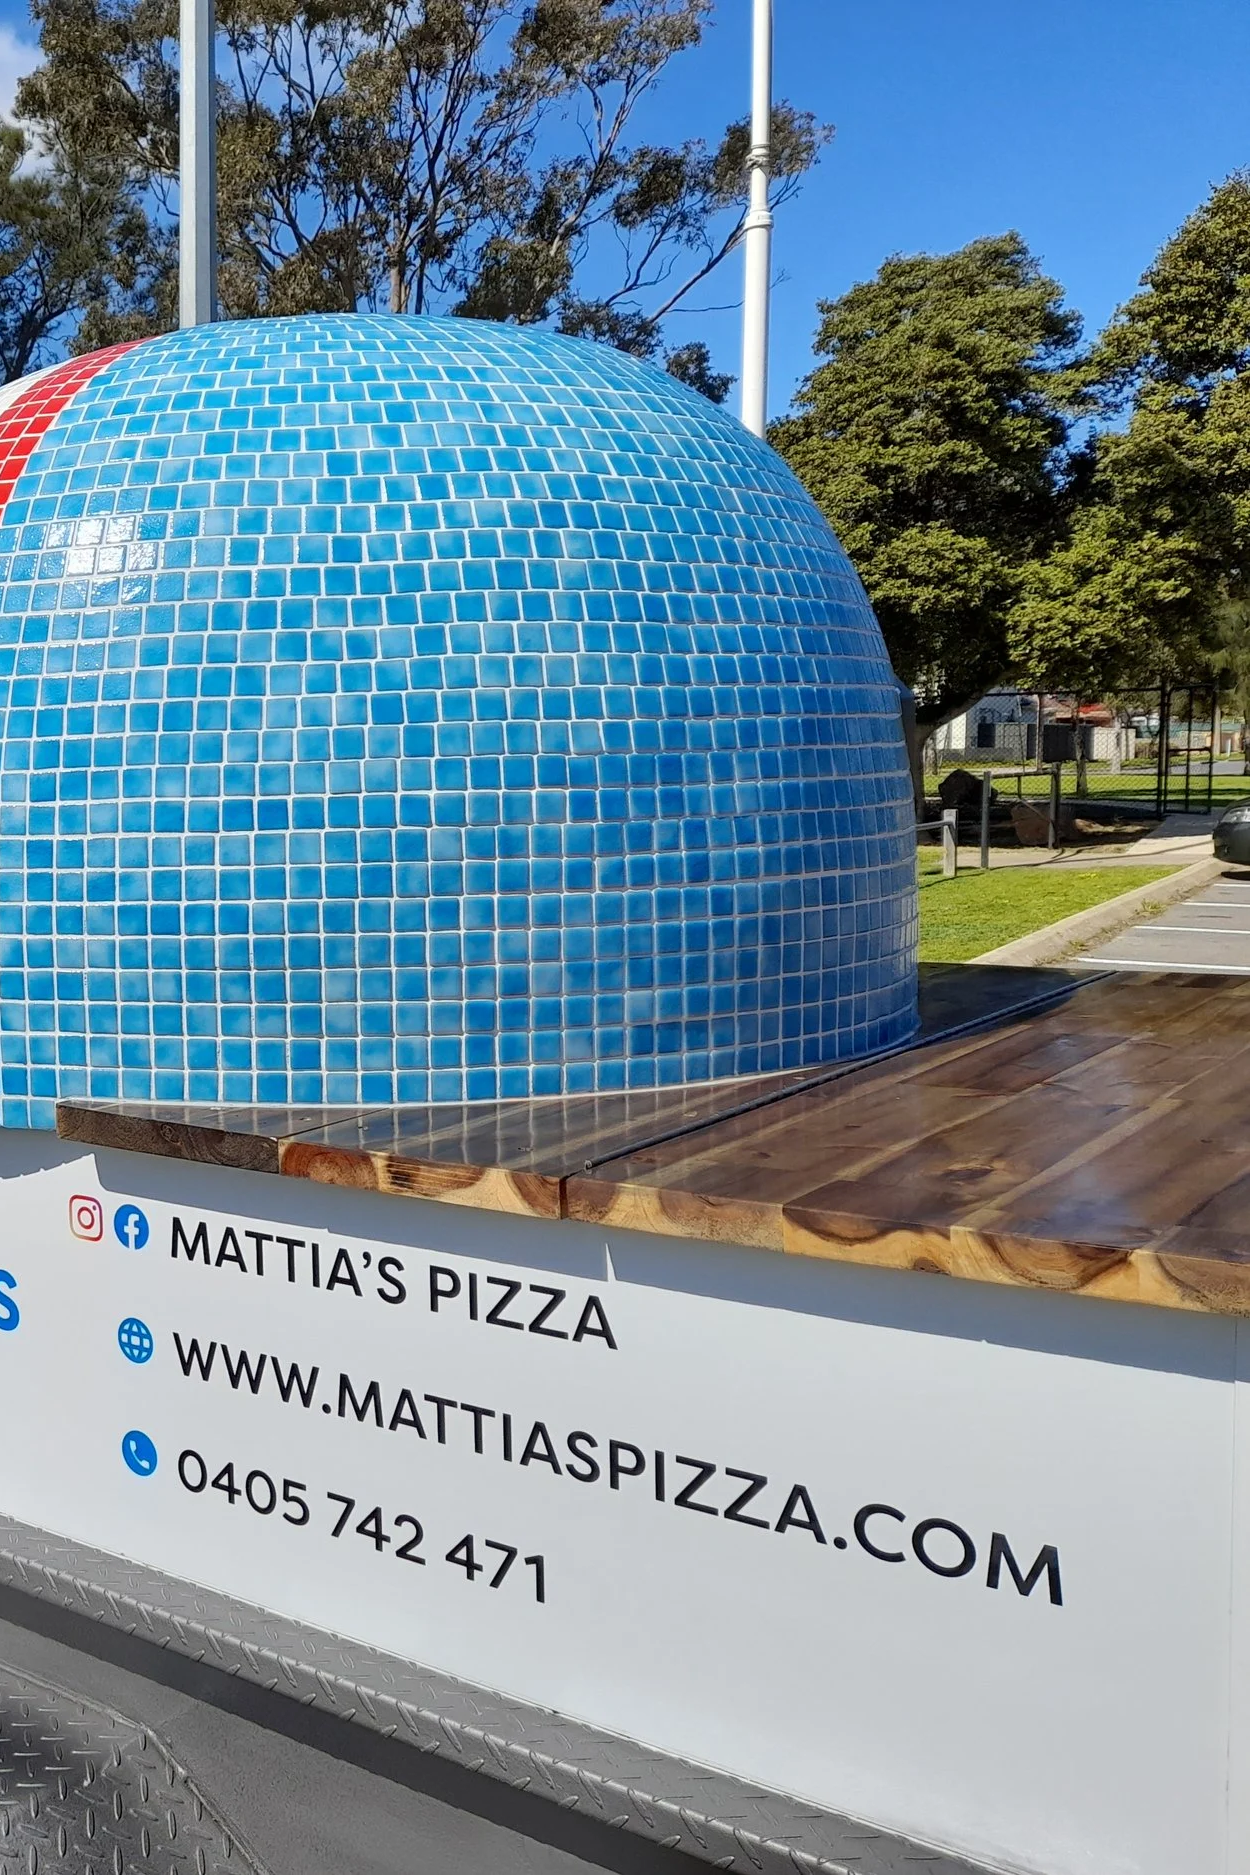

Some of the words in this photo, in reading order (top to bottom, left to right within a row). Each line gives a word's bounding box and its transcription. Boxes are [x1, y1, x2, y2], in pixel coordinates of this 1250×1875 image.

[170, 1216, 408, 1306] MATTIA'S
[429, 1264, 619, 1351] PIZZA
[172, 1331, 1064, 1608] WWW.MATTIASPIZZA.COM
[177, 1449, 311, 1526] 0405
[325, 1491, 426, 1566] 742
[444, 1534, 546, 1605] 471
